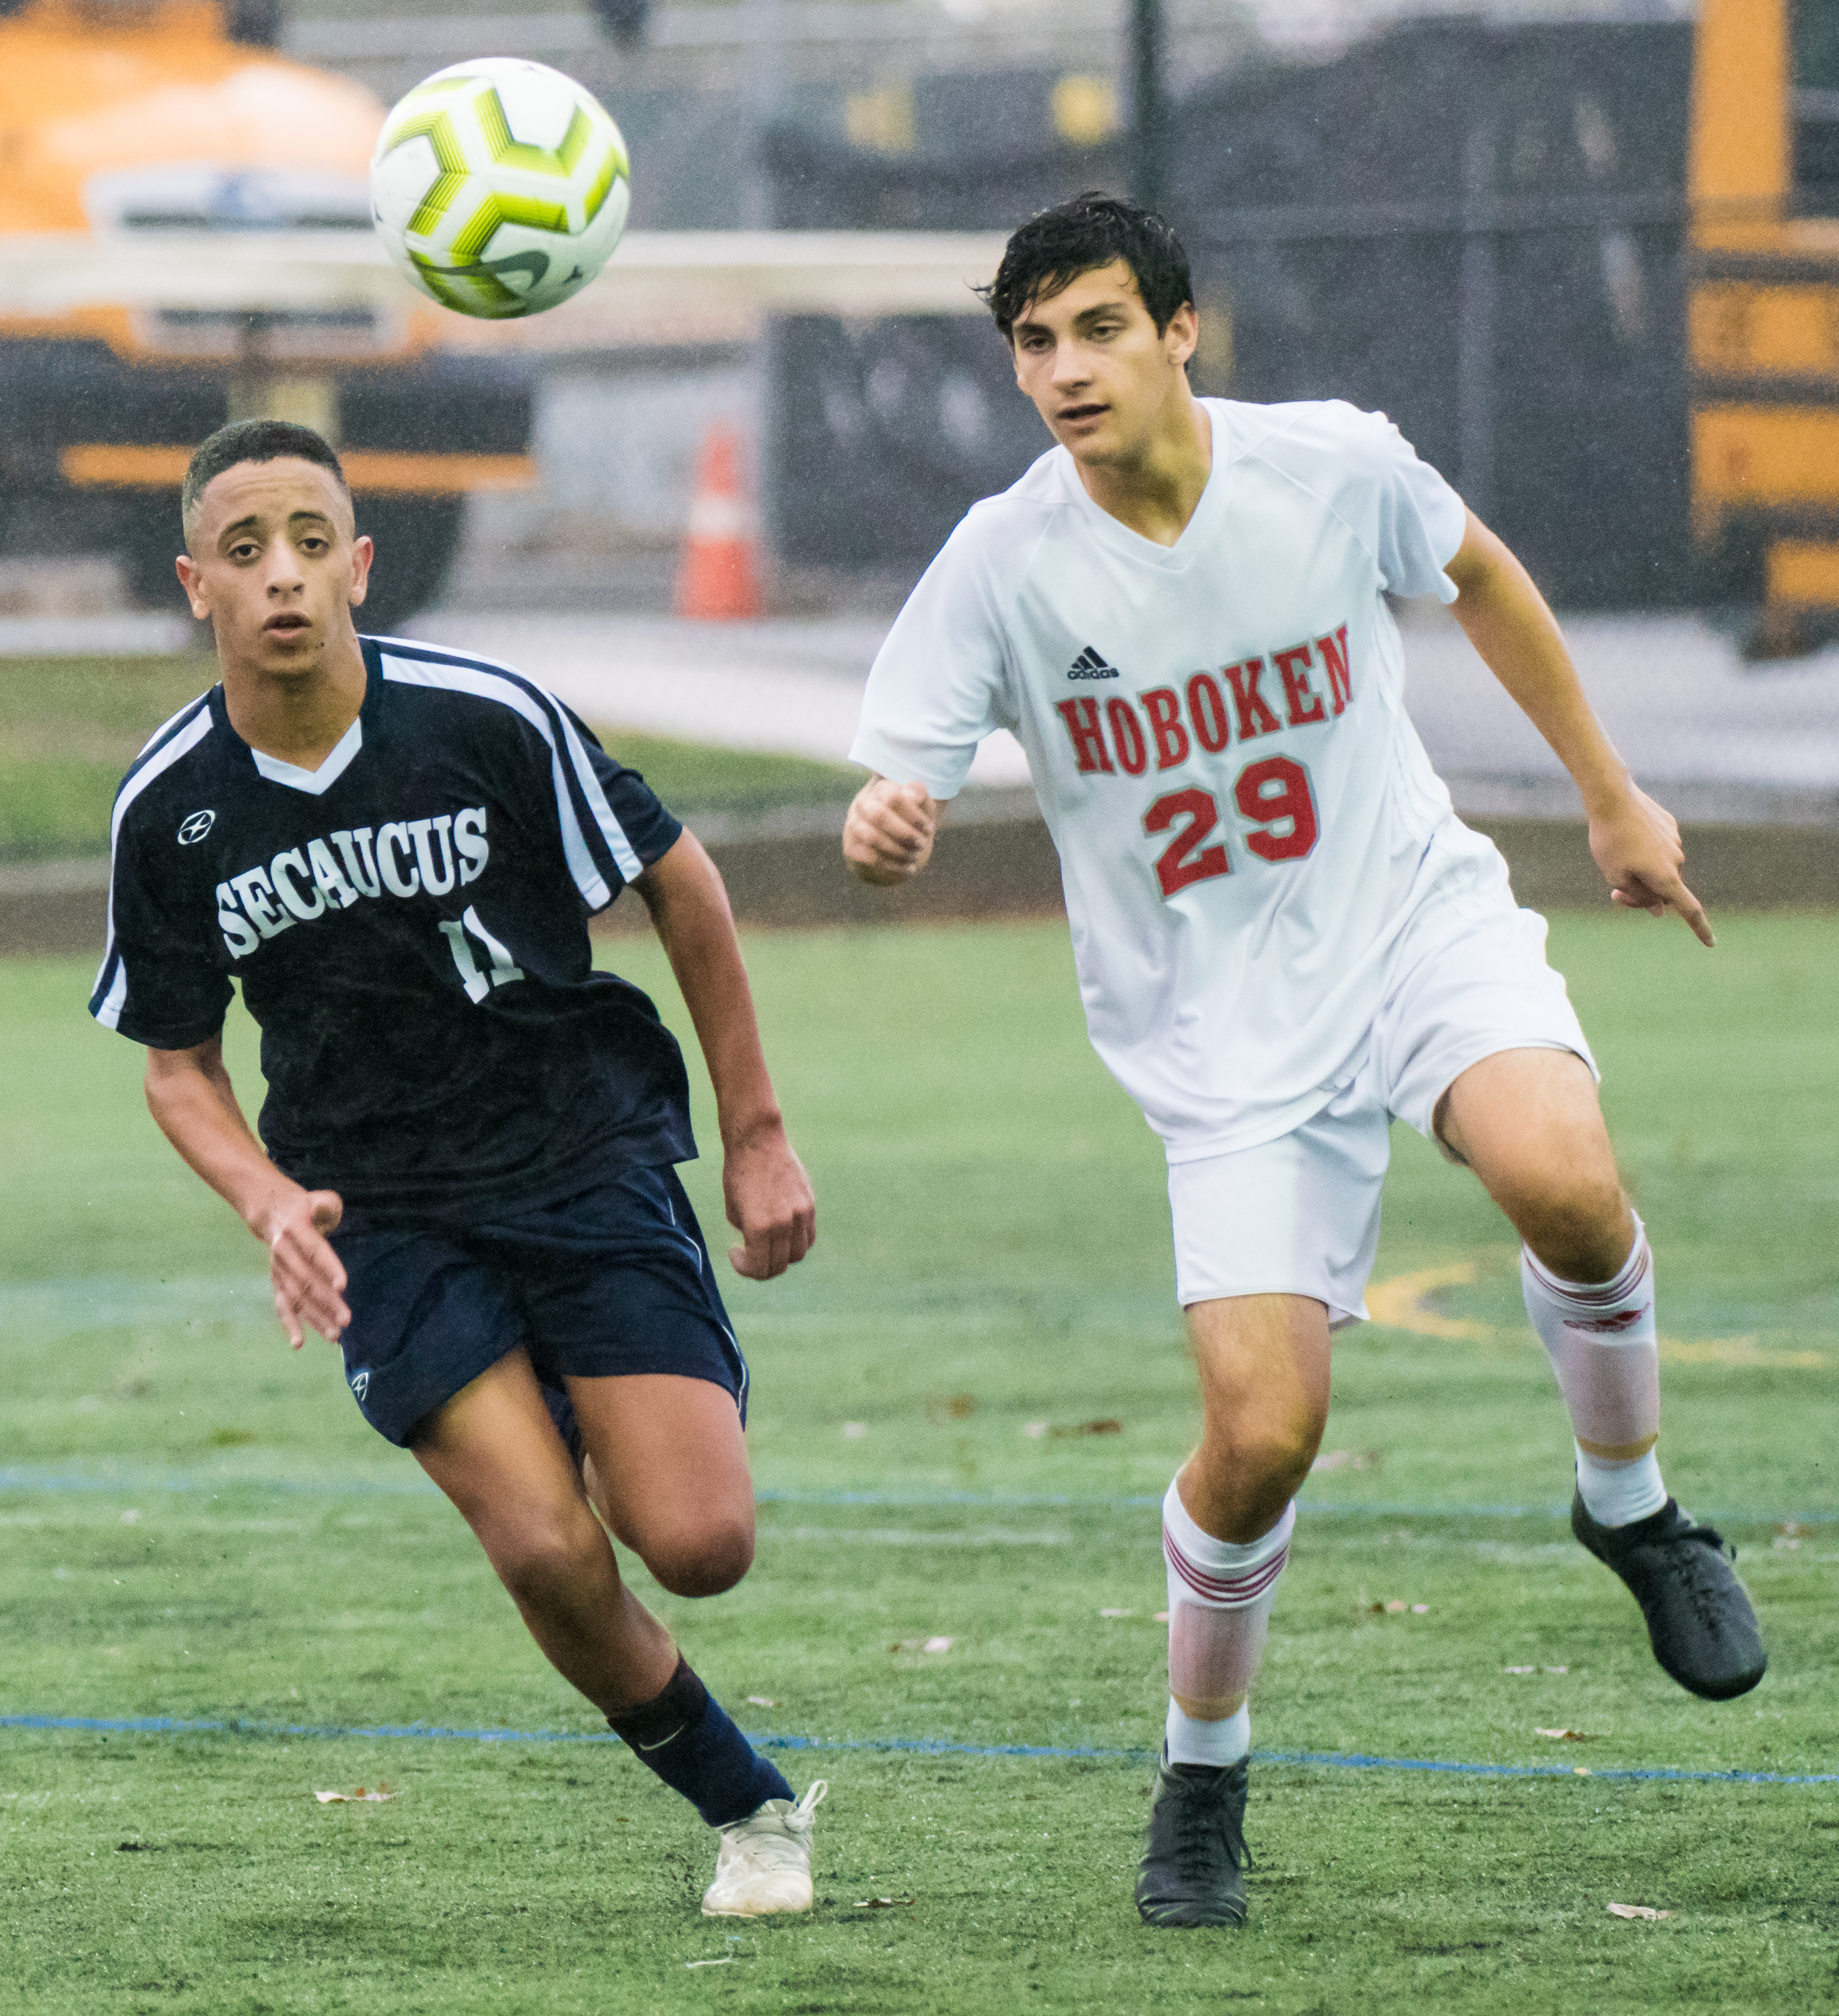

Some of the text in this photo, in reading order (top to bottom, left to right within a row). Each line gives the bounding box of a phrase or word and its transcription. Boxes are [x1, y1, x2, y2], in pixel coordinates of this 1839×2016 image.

[1053, 619, 1353, 777] HOBOKEN
[1067, 668, 1119, 680] adidas
[216, 807, 489, 959] SECAUCUS
[1141, 752, 1321, 901] 29
[438, 904, 525, 1004] 11
